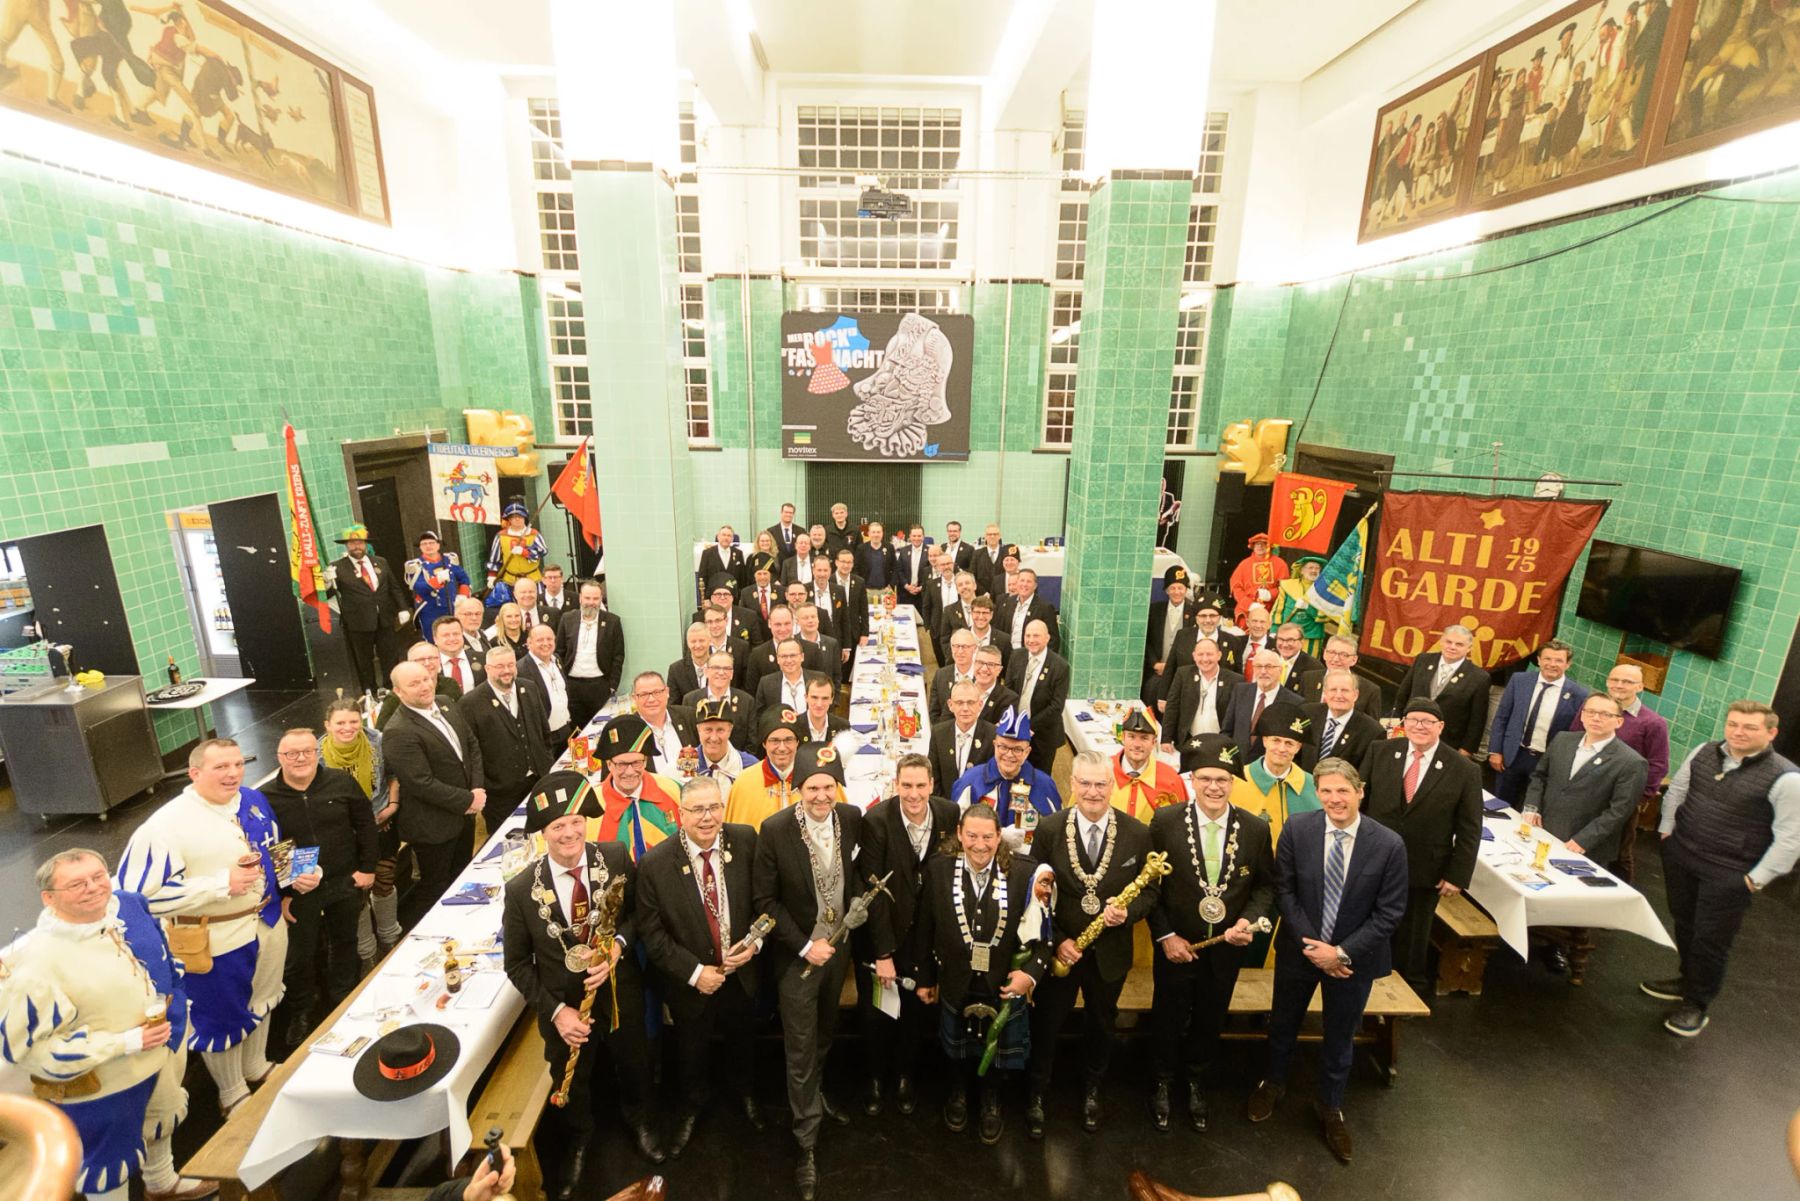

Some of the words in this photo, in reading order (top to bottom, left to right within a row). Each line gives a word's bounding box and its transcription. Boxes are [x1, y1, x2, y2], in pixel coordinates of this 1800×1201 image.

[787, 446, 818, 454] novitex
[290, 464, 305, 496] KRIENS
[296, 499, 314, 558] GALLI-ZUNFT
[1385, 527, 1494, 568] ALTI
[1508, 537, 1540, 554] 19
[1504, 554, 1536, 573] 75
[1380, 566, 1547, 615] GARDE
